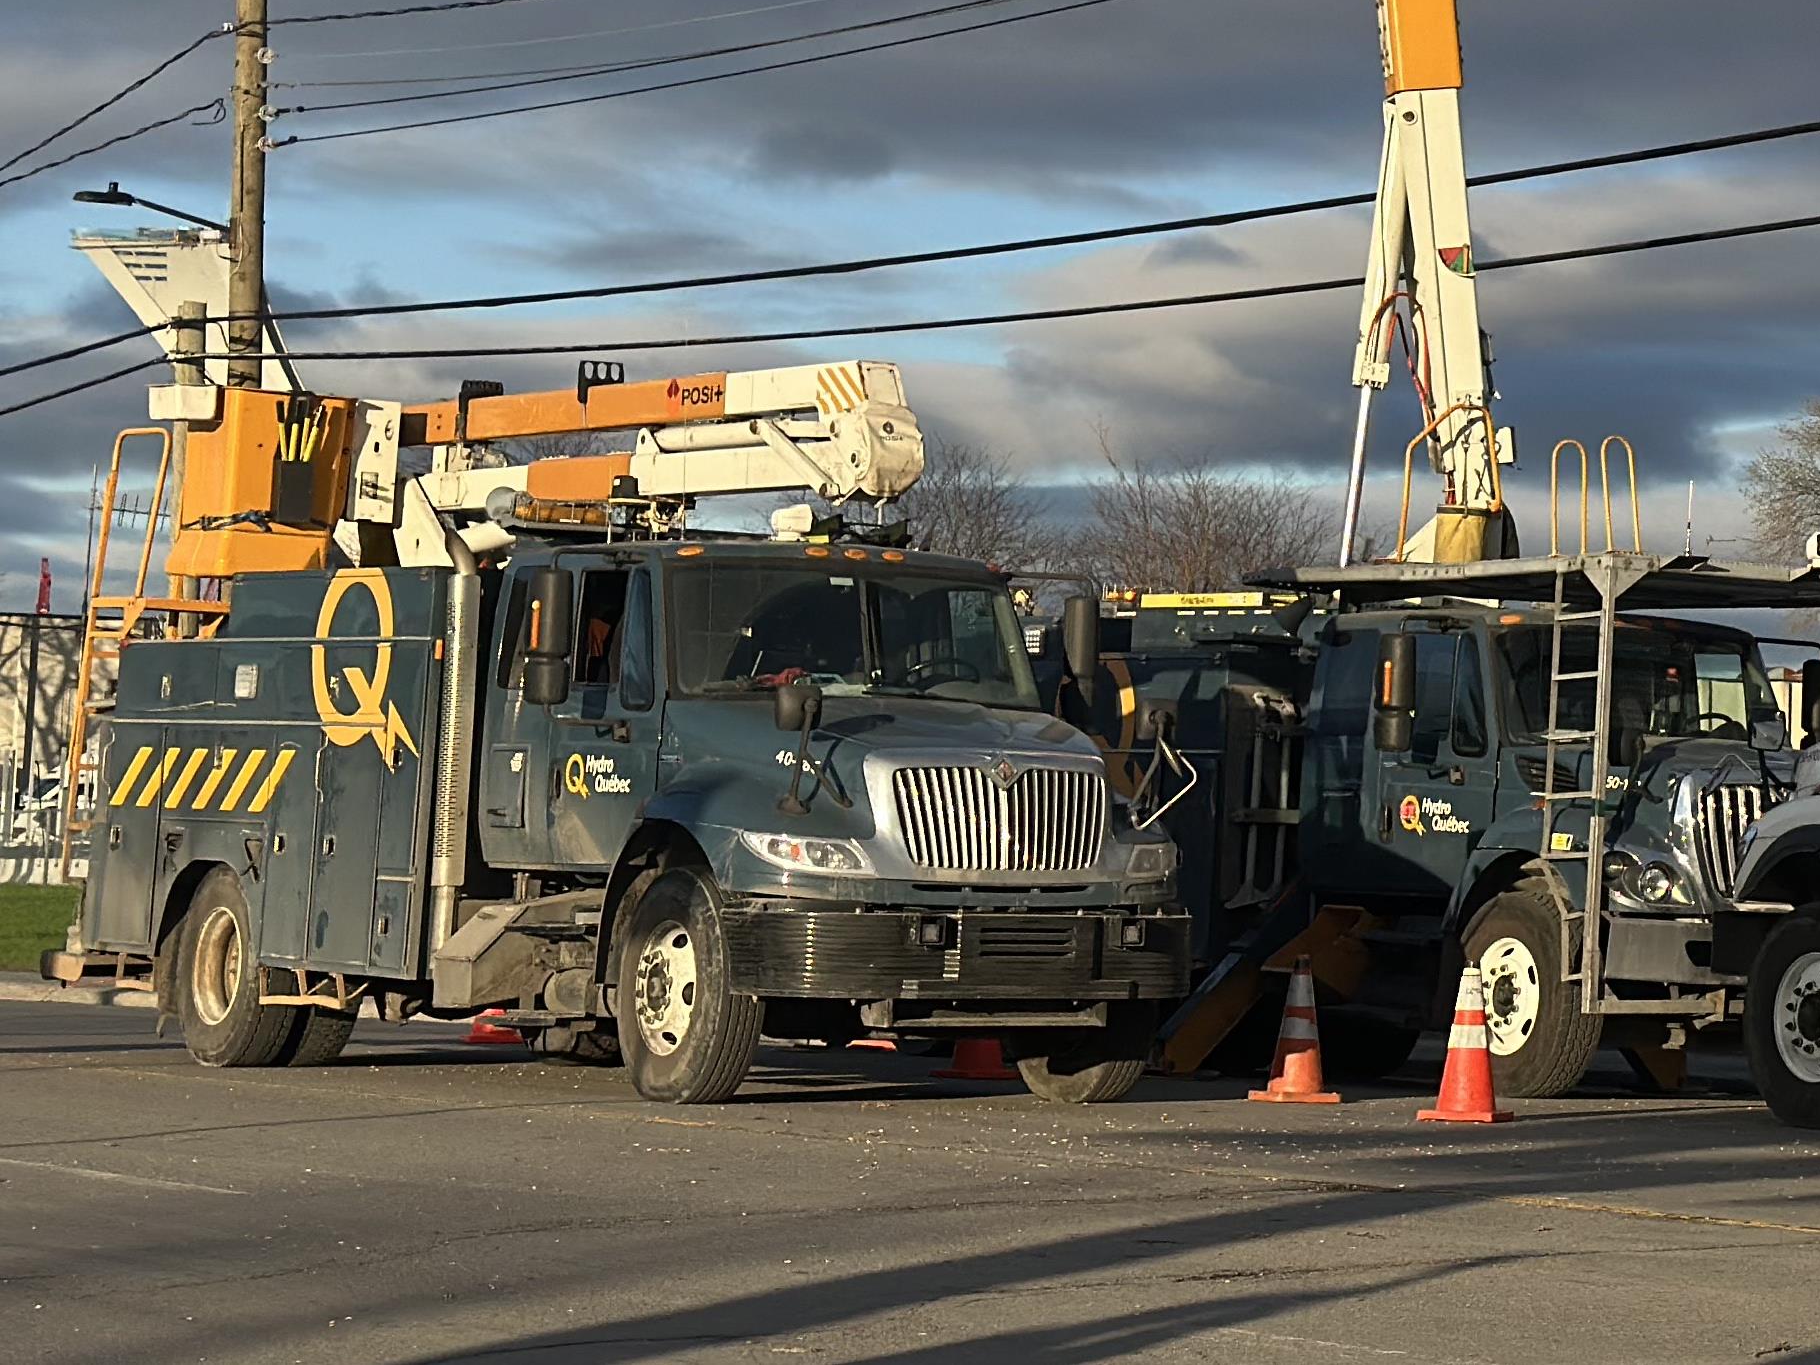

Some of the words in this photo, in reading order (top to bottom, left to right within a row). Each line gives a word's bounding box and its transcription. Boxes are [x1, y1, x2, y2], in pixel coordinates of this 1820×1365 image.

[681, 384, 724, 406] POSI+
[585, 755, 614, 776] Hydro
[594, 774, 631, 793] Québec
[1421, 797, 1452, 817] Hydro
[1431, 815, 1470, 834] Québec
